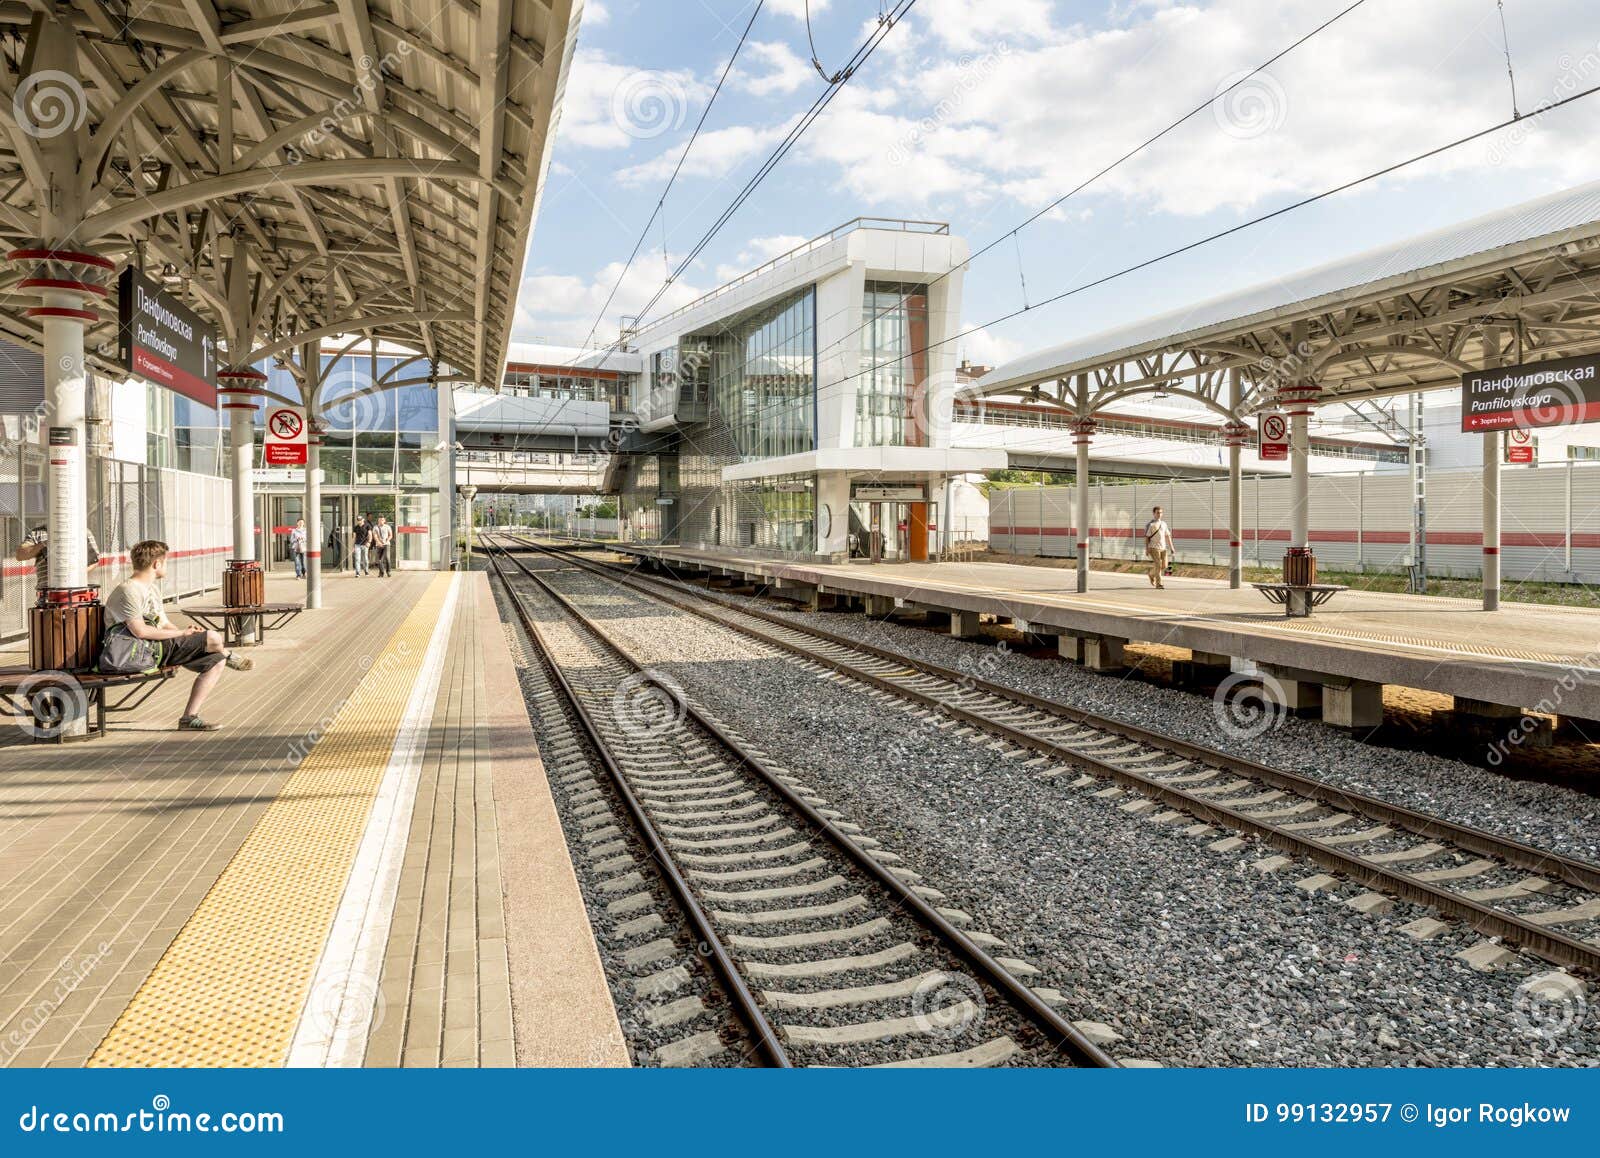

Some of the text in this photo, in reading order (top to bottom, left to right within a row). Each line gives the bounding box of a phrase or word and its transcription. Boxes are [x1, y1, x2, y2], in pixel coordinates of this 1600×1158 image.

[137, 285, 193, 341] Панфиловская
[137, 323, 178, 362] Panfilovskaya
[1471, 366, 1595, 393] Панфиловская
[1472, 394, 1551, 411] Panfilovskaya
